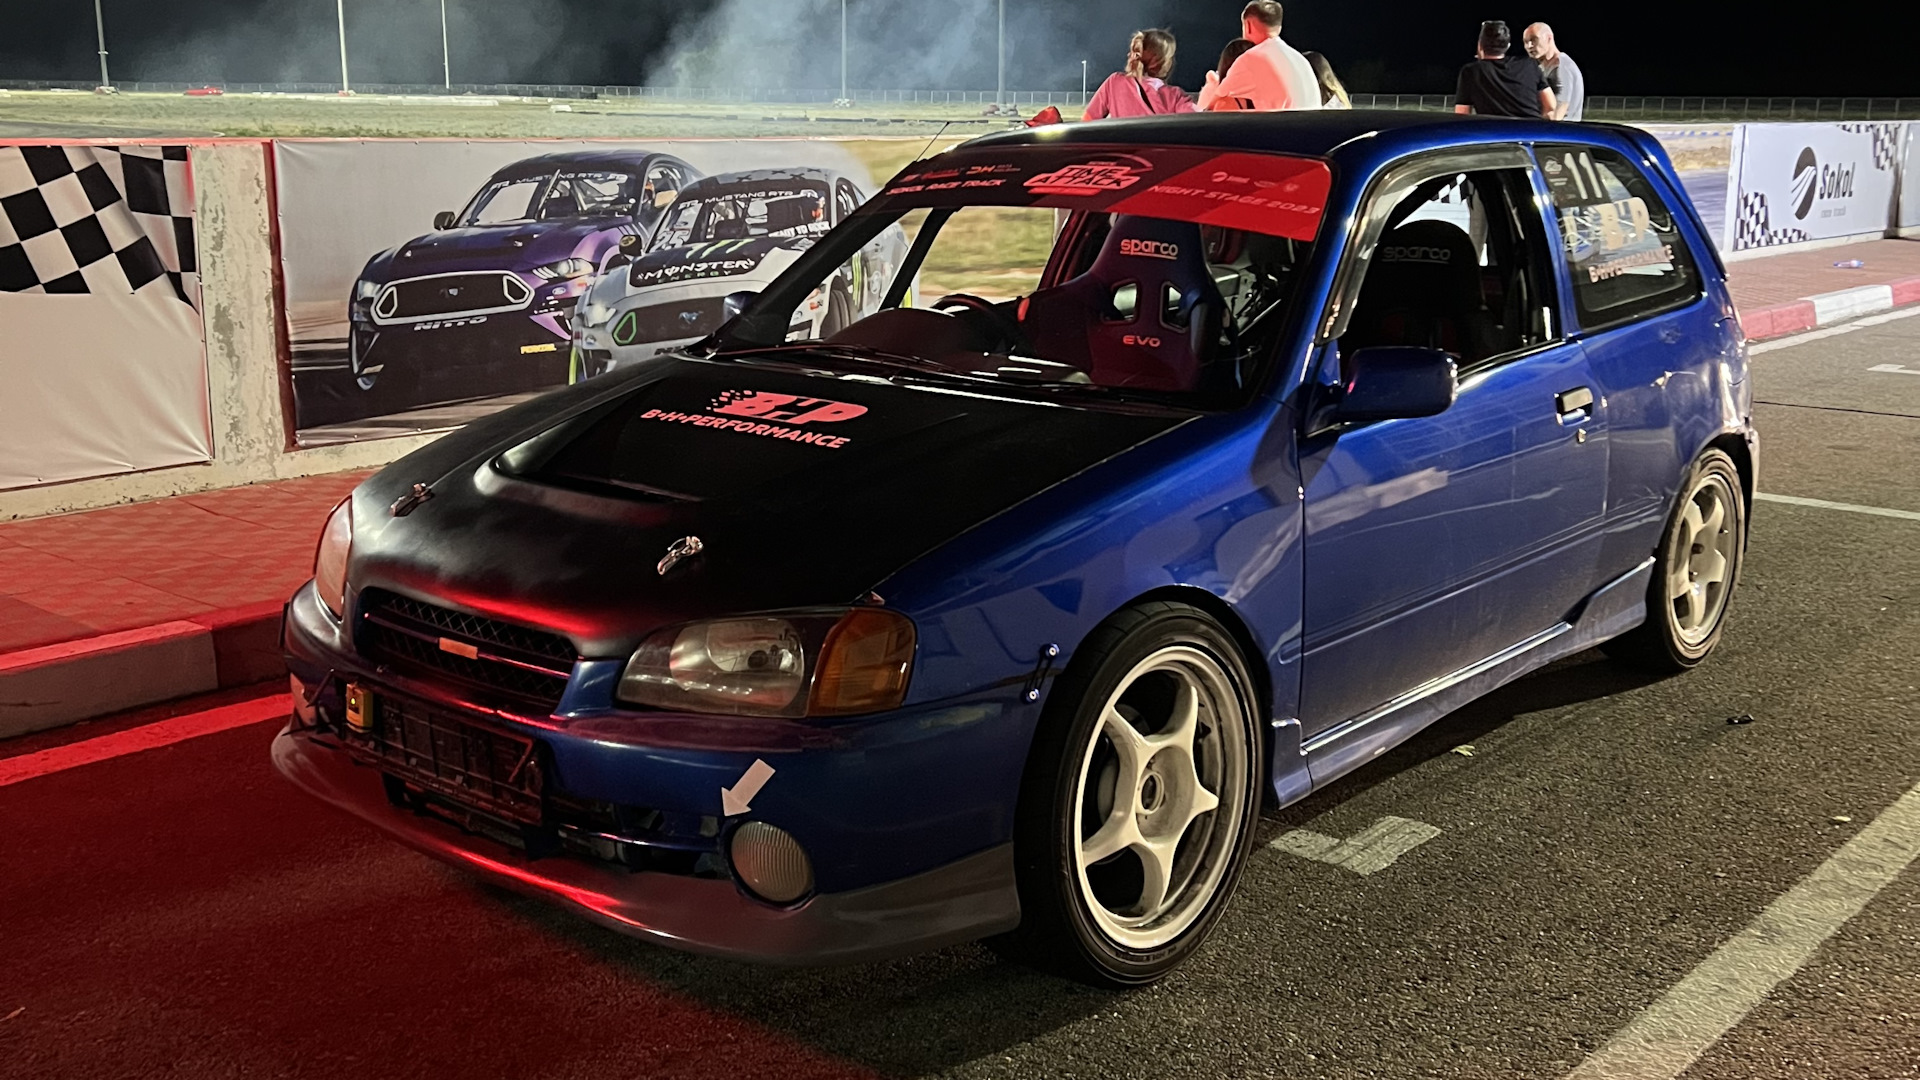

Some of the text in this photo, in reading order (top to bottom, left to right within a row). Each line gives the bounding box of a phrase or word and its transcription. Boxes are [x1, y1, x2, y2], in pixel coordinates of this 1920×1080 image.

[515, 173, 576, 184] MUSTANG
[1030, 175, 1138, 187] ATTACK
[1064, 167, 1121, 178] TIME
[1564, 152, 1603, 200] 11
[1819, 162, 1856, 200] Sokol
[704, 190, 766, 204] MUSTANG
[768, 190, 794, 198] RTR
[1149, 185, 1321, 214] NIGHT STAGE 2023
[1120, 238, 1179, 258] sparco
[1382, 245, 1452, 263] sparco
[638, 258, 756, 280] MONSTER
[413, 315, 488, 331] NITTO
[1122, 334, 1161, 348] EVO
